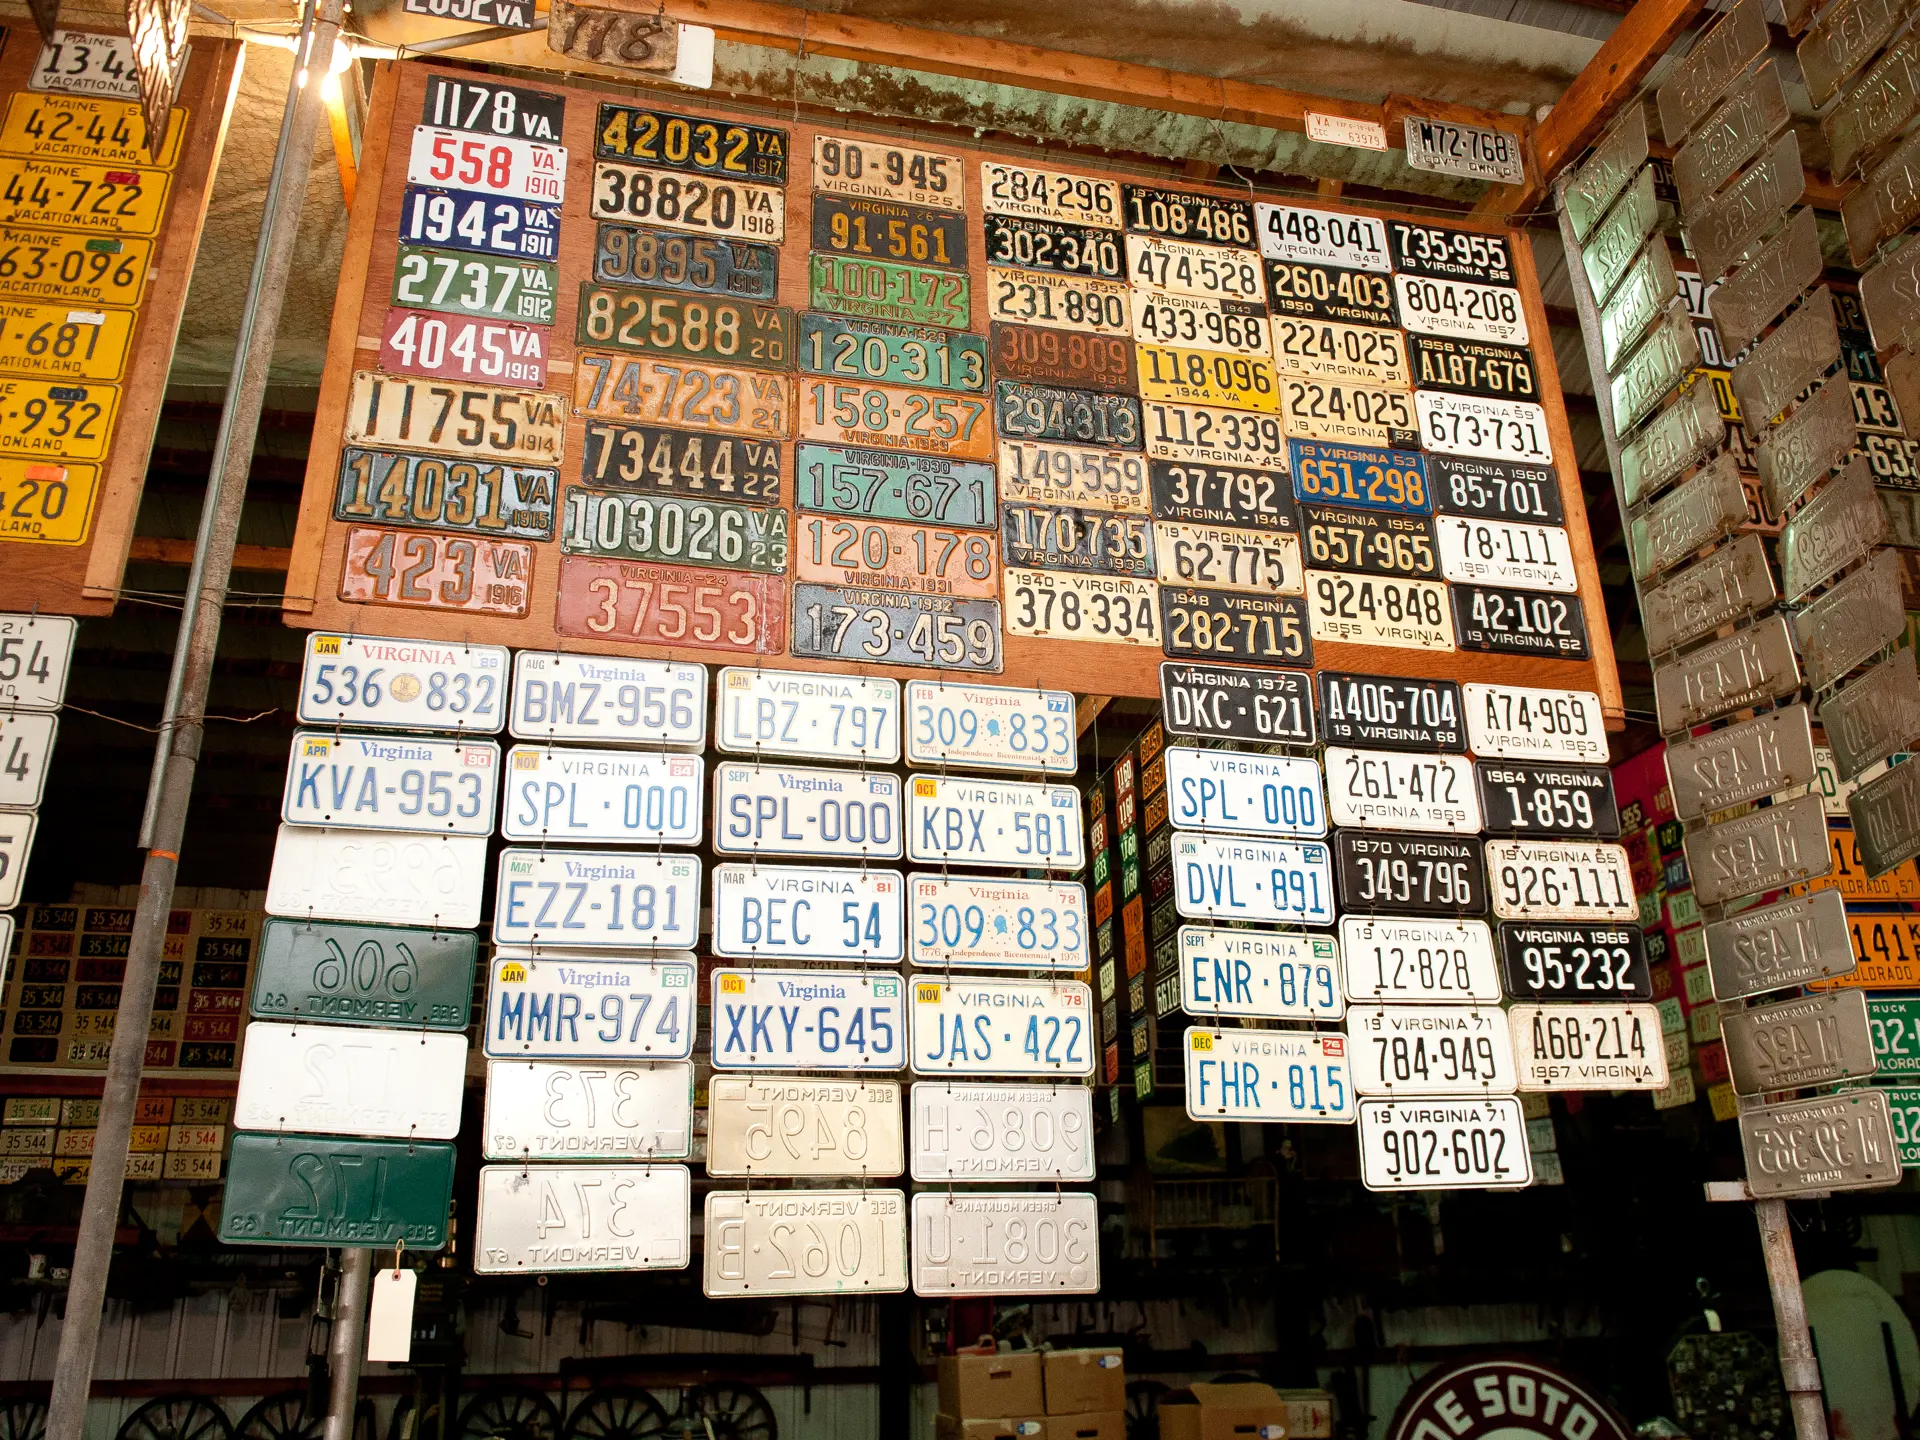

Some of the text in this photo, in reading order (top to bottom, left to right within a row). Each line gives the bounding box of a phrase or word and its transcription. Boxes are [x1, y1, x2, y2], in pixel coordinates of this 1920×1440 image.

[44, 96, 99, 113] MAINE
[434, 82, 515, 134] 1178
[34, 142, 138, 160] VACATIONLAND
[602, 111, 750, 173] 42032
[754, 131, 782, 156] VA
[429, 138, 512, 188] 558
[4, 174, 143, 216] 44-722
[526, 175, 558, 196] 1910
[599, 169, 736, 229] 38820
[411, 193, 518, 251] 1942
[993, 201, 1114, 224] VIRGINIA 1933
[521, 234, 552, 256] 1911
[602, 229, 718, 288] 9895
[398, 256, 520, 313] 2737
[518, 296, 552, 318] 1912
[1280, 300, 1391, 322] 1950 VIRGINIA
[586, 292, 741, 355] 82588
[389, 317, 505, 376] 4045
[508, 329, 541, 358] VA
[1419, 340, 1524, 360] 1958 VIRGINIA
[504, 362, 539, 380] 1913
[365, 381, 520, 449] 11755
[752, 409, 781, 430] 21
[590, 427, 734, 493] 73444
[345, 454, 507, 529] 14031
[514, 473, 550, 504] VA
[742, 474, 779, 496] 22
[567, 494, 744, 562] 103026
[751, 508, 788, 538] VA
[1310, 510, 1425, 532] VIRGINIA 1954
[364, 534, 476, 604] 423
[486, 584, 522, 606] 1916
[1172, 593, 1297, 614] 1948 VIRGINIA
[587, 578, 757, 645] 37553
[317, 644, 339, 653] JAN
[362, 645, 456, 665] VIRGINIA
[526, 659, 545, 669] AUG
[579, 664, 646, 682] Virginia
[1173, 671, 1297, 691] VIRGINIA 1972
[524, 680, 693, 728] BMZ-956
[1487, 771, 1603, 787] 1964 VIRGINIA
[297, 763, 482, 818] KVA-953
[730, 794, 891, 844] SPL-000
[766, 878, 855, 894] VIRGINIA
[876, 883, 891, 892] 81
[968, 887, 1030, 900] Virginia
[506, 881, 679, 931] EZZ-181
[1060, 894, 1076, 903] 78
[742, 897, 881, 948] BEC 54
[1186, 936, 1204, 947] SEPT
[1514, 930, 1629, 944] VIRGINIA 1966
[502, 971, 524, 982] JAN
[558, 968, 631, 988] Virginia
[777, 981, 846, 1001] Virginia
[919, 990, 938, 1001] NOV
[498, 991, 680, 1042] MMR-974
[724, 1004, 893, 1053] XKY-645
[1194, 1038, 1211, 1049] DEC
[1531, 1066, 1653, 1078] 1967 VIRGINIA
[1373, 1109, 1506, 1123] 19 VIRGINIA 71
[1473, 1374, 1598, 1440] SOTO
